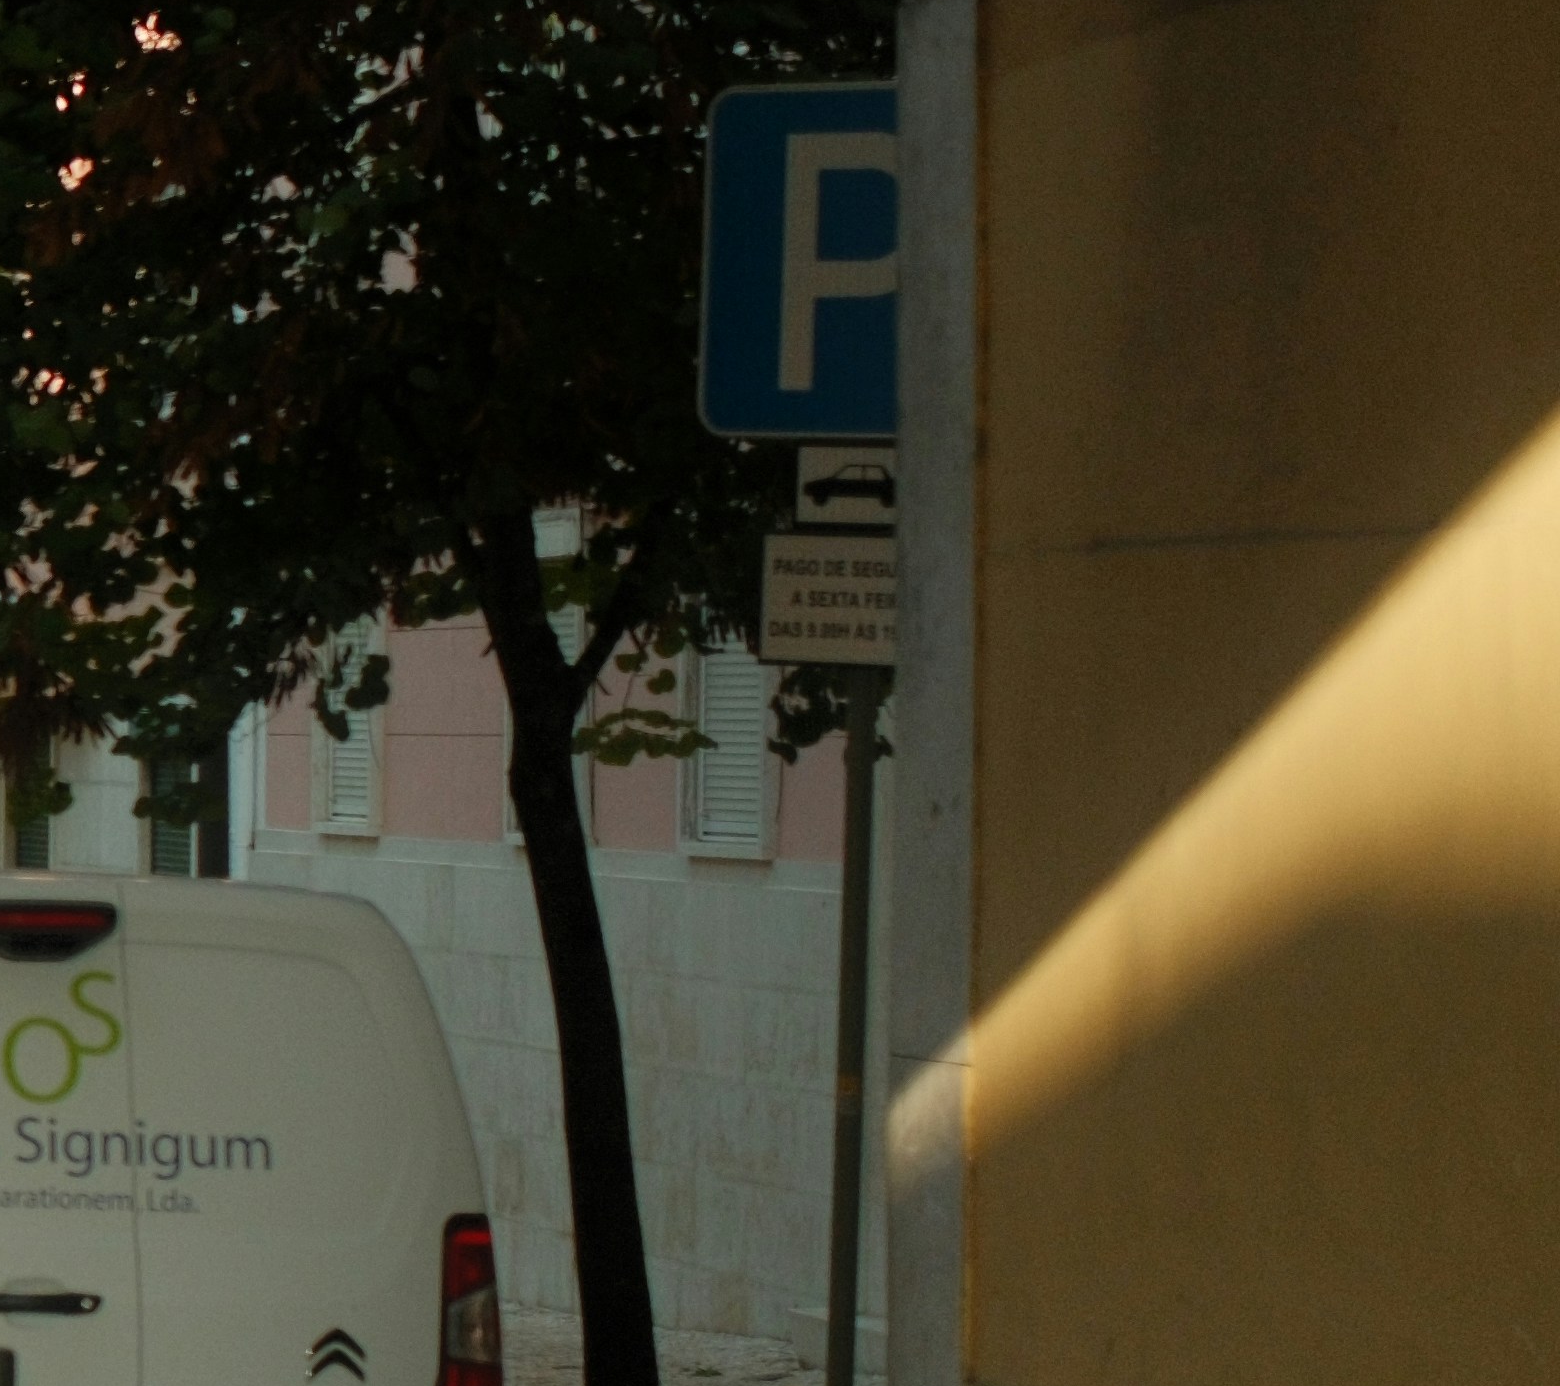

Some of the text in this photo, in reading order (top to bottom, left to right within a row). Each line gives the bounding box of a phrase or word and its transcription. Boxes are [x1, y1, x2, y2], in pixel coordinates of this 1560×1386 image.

[778, 130, 897, 392] P
[773, 558, 819, 577] PAGO
[823, 559, 846, 577] DE
[808, 590, 860, 608] SEXTA
[768, 621, 802, 639] DAS
[15, 1116, 273, 1181] Signigum
